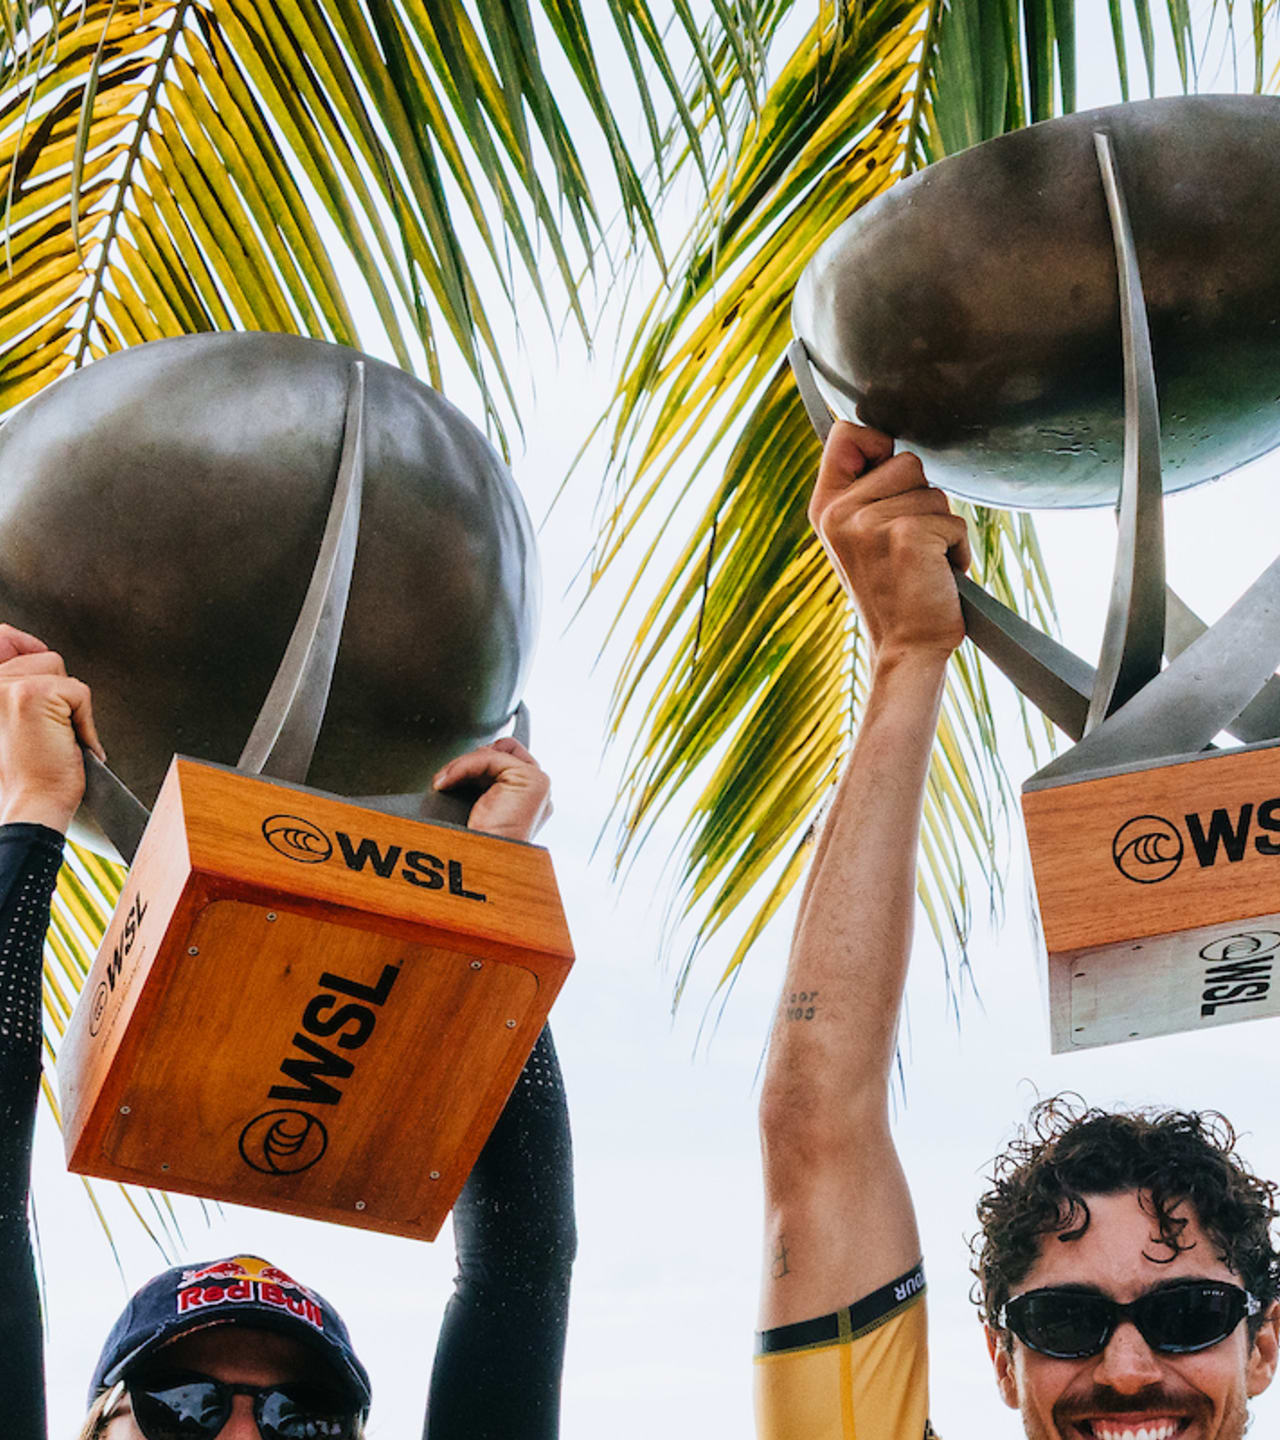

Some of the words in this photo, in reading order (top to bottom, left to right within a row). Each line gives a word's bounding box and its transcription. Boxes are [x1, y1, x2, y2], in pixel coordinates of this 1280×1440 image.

[335, 831, 487, 903] WSL
[107, 890, 148, 992] WSL
[1201, 955, 1274, 1017] WSL
[268, 964, 400, 1106] WSL
[177, 1279, 255, 1315] Red
[257, 1281, 324, 1331] Bull
